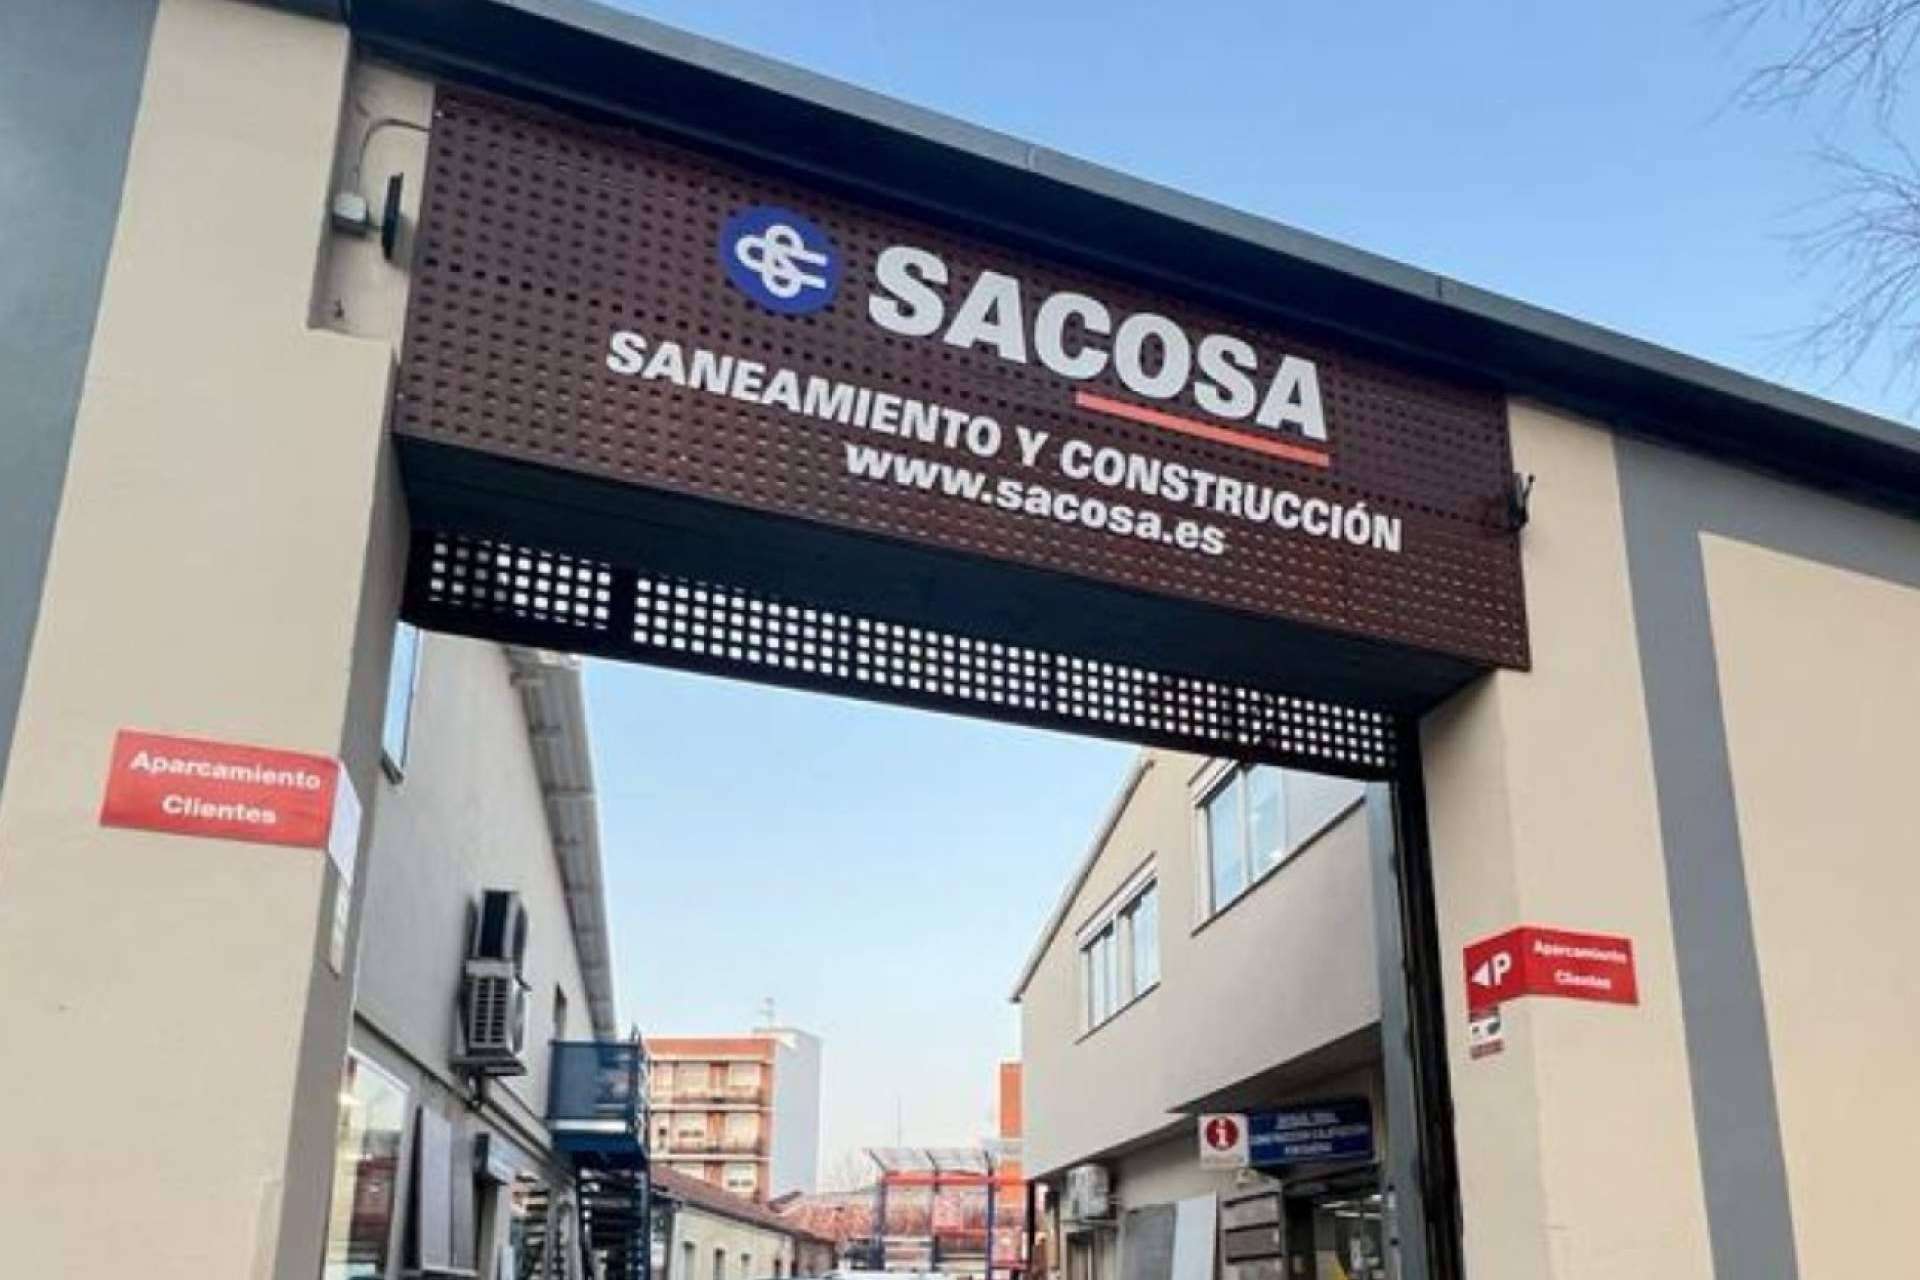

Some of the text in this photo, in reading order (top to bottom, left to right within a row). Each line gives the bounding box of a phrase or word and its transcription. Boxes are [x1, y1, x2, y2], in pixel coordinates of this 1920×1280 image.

[868, 246, 1328, 441] SACOSA
[606, 331, 1402, 552] SANEAMIENTO Y CONSTRUCCIÓN
[845, 442, 1226, 555] www.sacosa.es
[130, 751, 321, 789] Aparcamiento
[162, 795, 276, 824] Clientes
[1492, 952, 1511, 986] P
